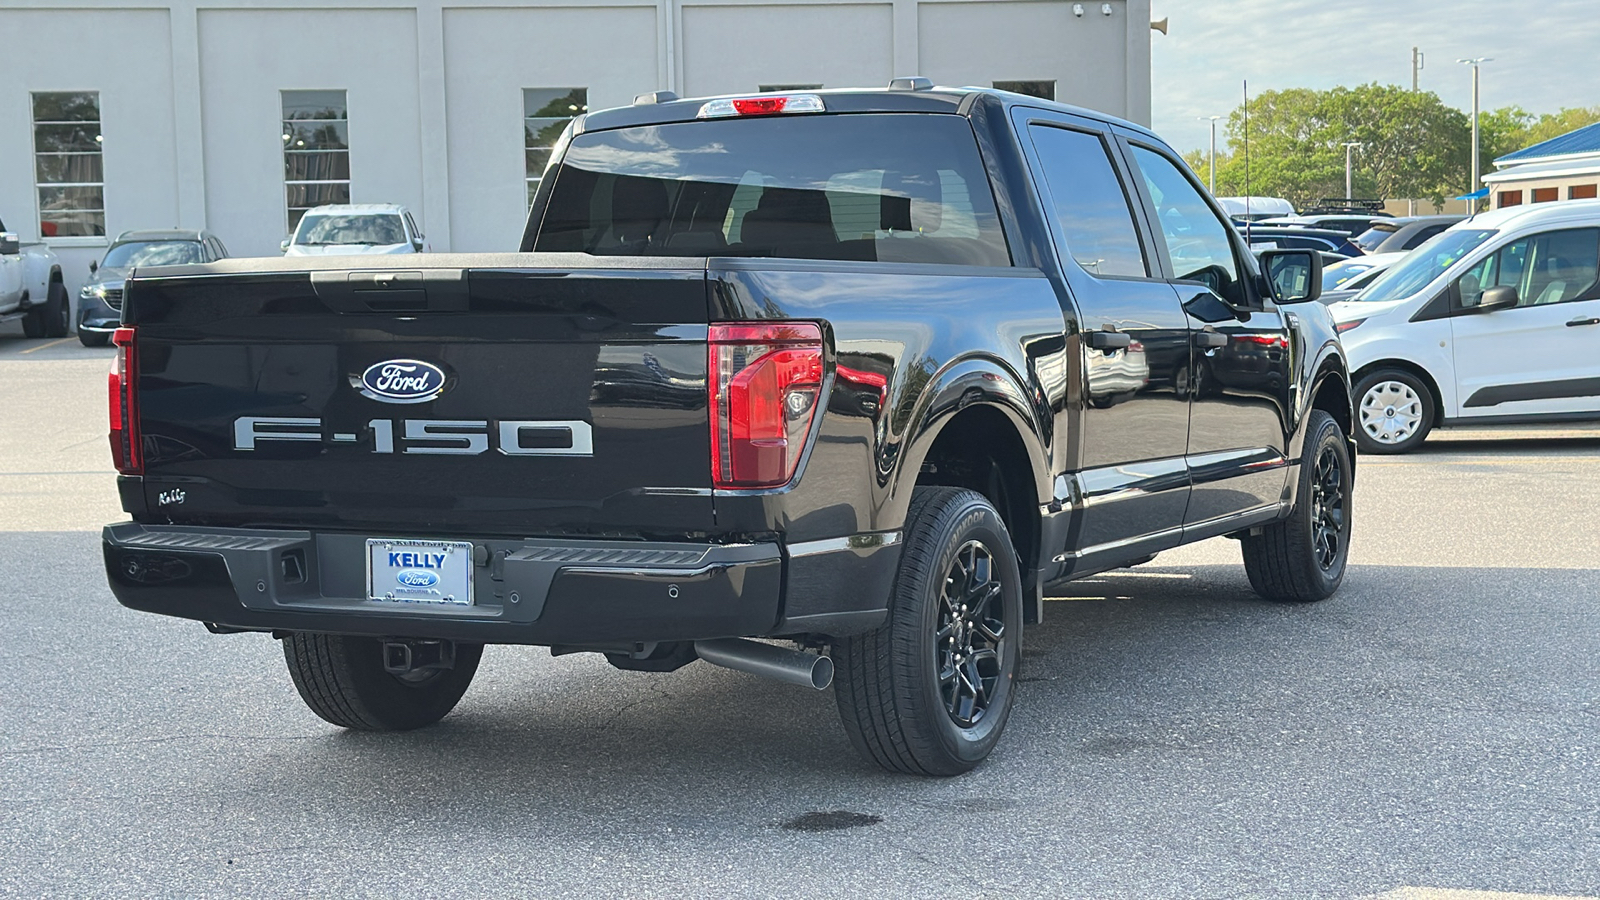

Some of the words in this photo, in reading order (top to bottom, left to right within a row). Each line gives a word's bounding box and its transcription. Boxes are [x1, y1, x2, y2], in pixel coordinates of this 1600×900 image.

[376, 364, 430, 391] Ford
[234, 416, 594, 457] F-150
[158, 488, 186, 507] Kelly
[388, 552, 446, 569] KELLY
[404, 571, 430, 586] Ford
